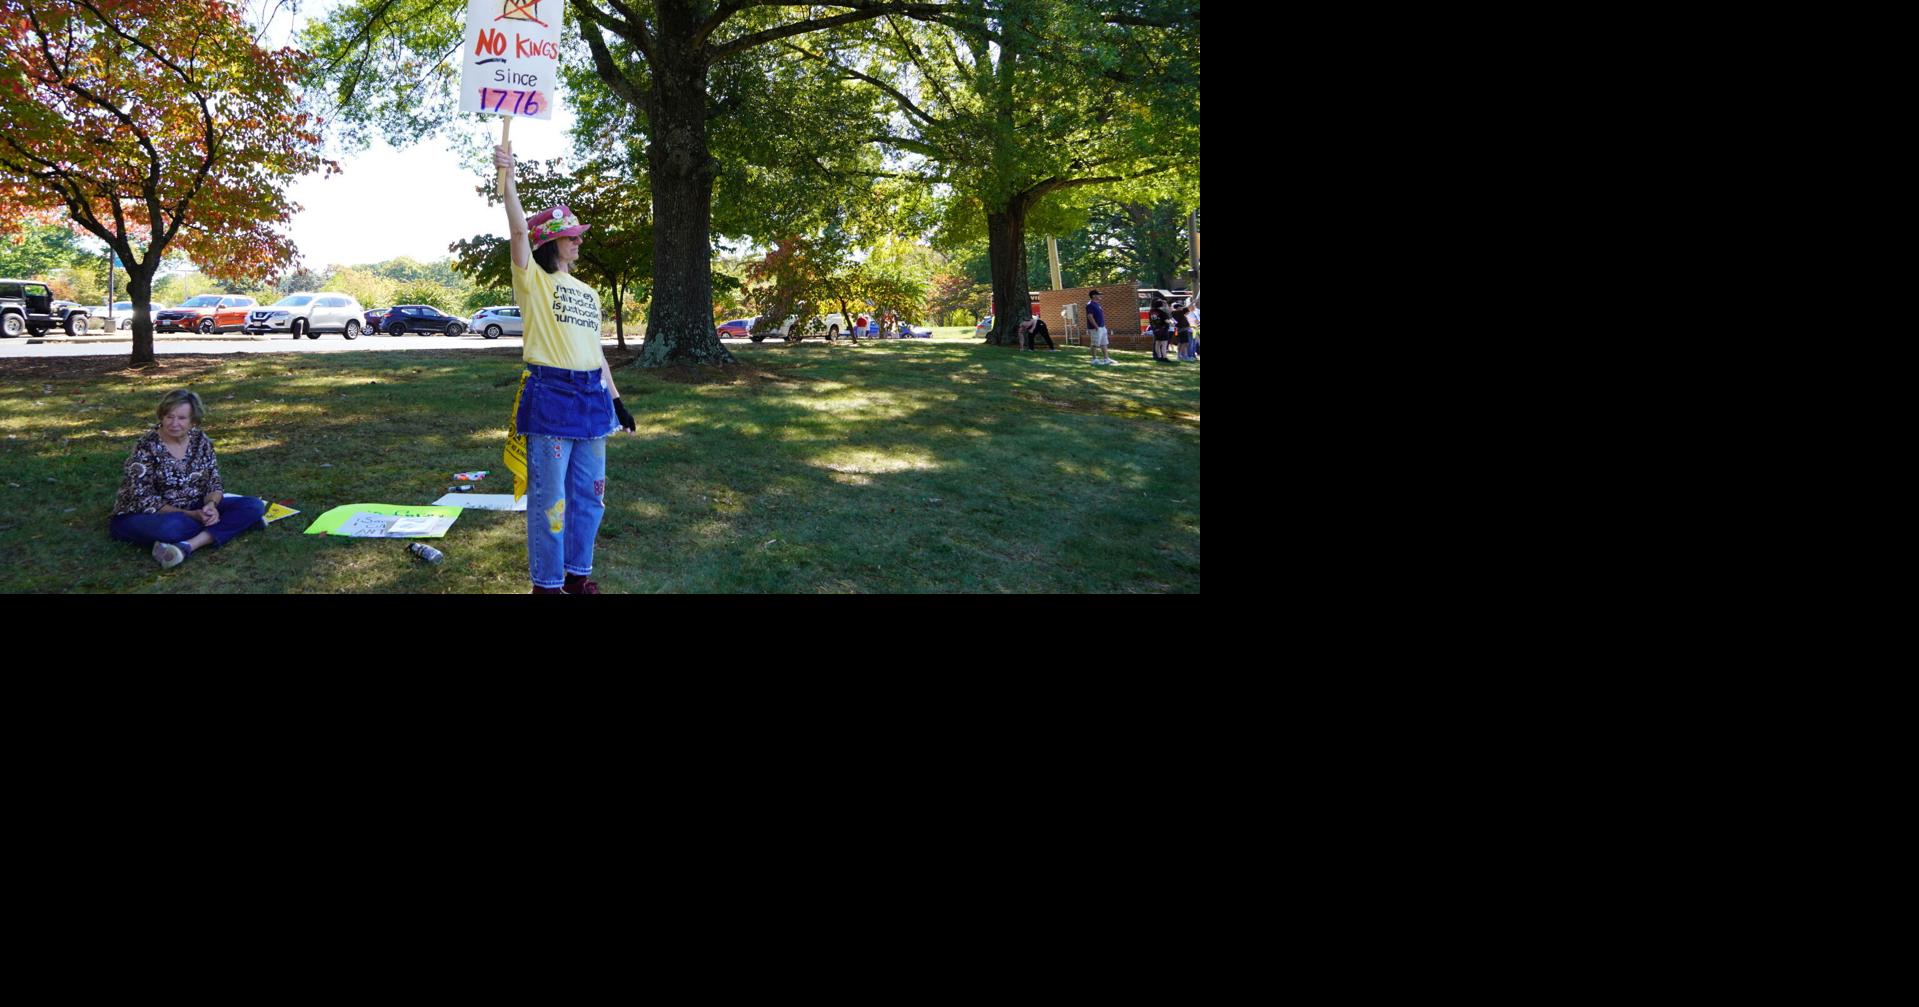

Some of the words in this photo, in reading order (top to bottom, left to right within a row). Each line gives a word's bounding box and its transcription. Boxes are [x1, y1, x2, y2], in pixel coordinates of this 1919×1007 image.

[475, 28, 507, 57] NO
[516, 33, 558, 60] KINGS
[480, 87, 540, 116] 1776
[552, 300, 562, 310] is
